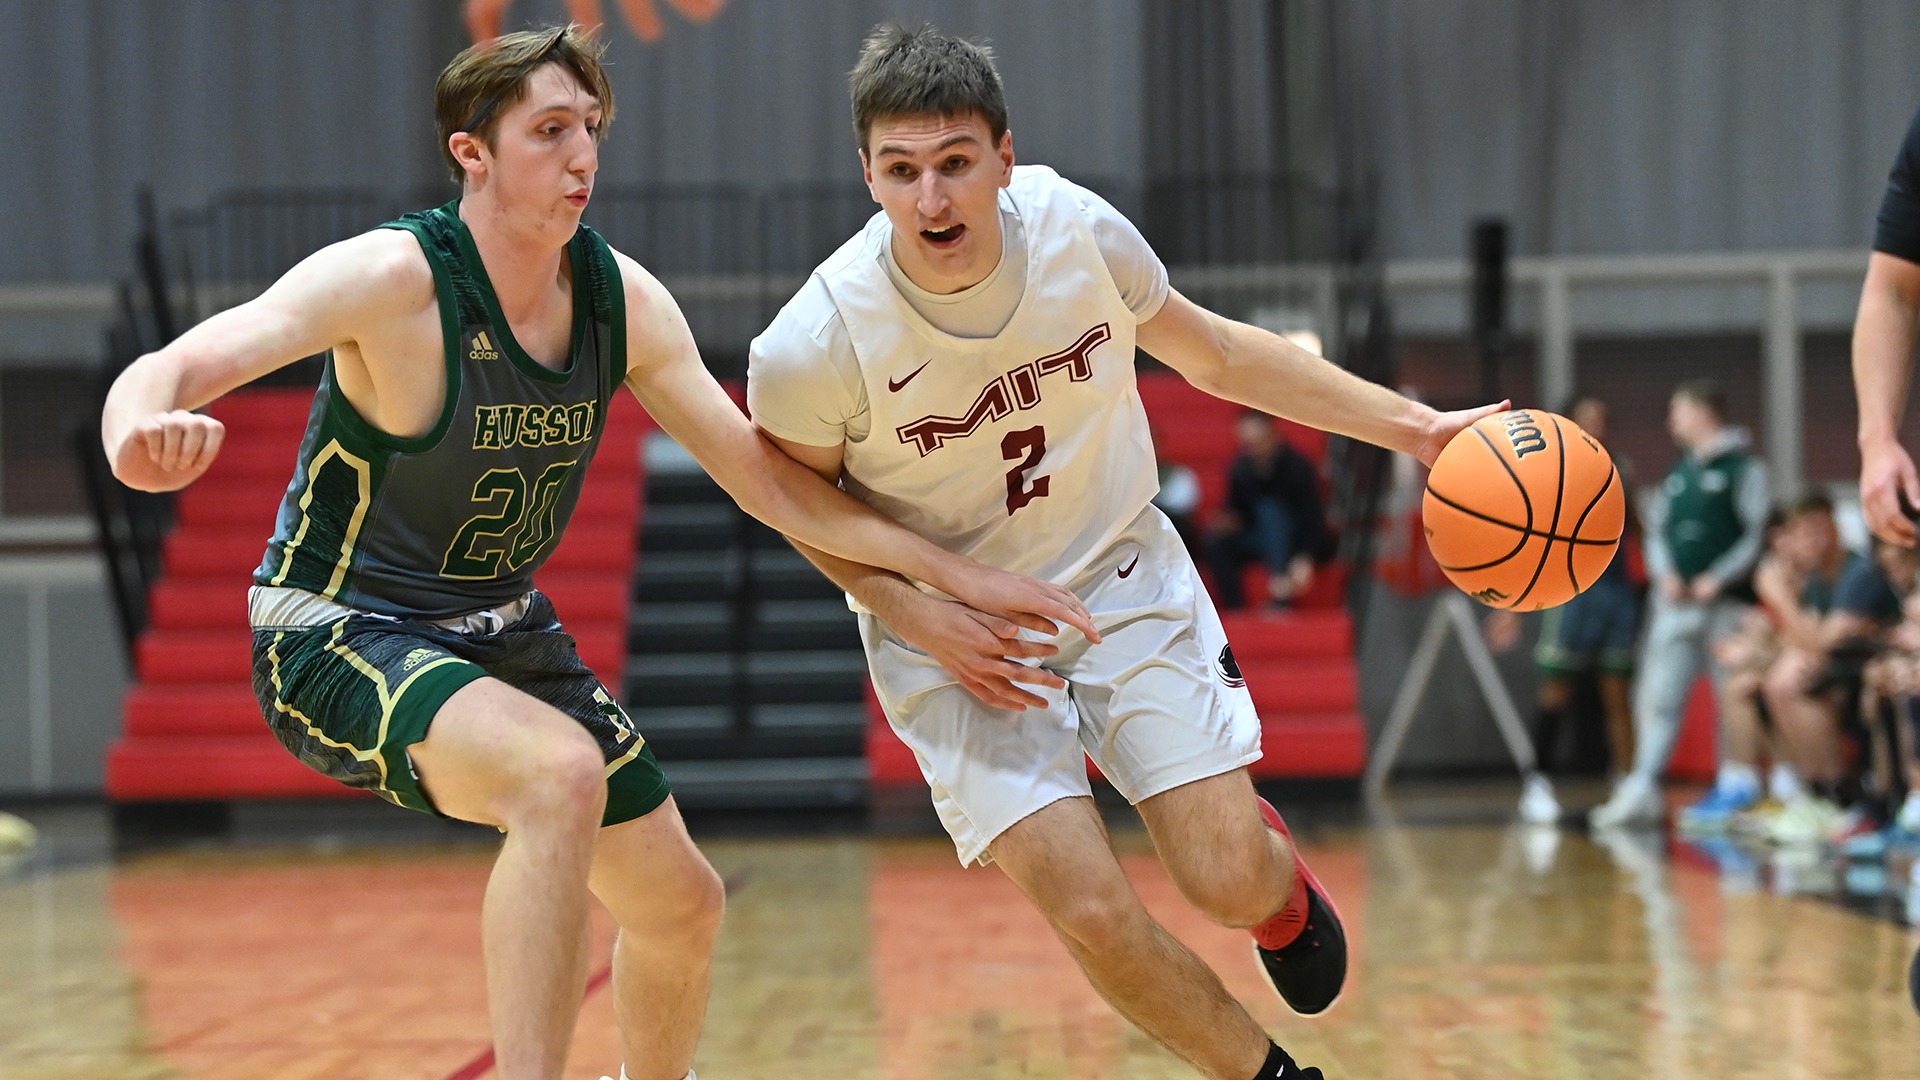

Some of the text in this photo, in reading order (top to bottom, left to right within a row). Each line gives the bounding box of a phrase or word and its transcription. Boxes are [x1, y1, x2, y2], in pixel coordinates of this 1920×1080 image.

[896, 322, 1112, 458] MIT
[439, 460, 577, 580] 20
[1000, 425, 1050, 517] 2
